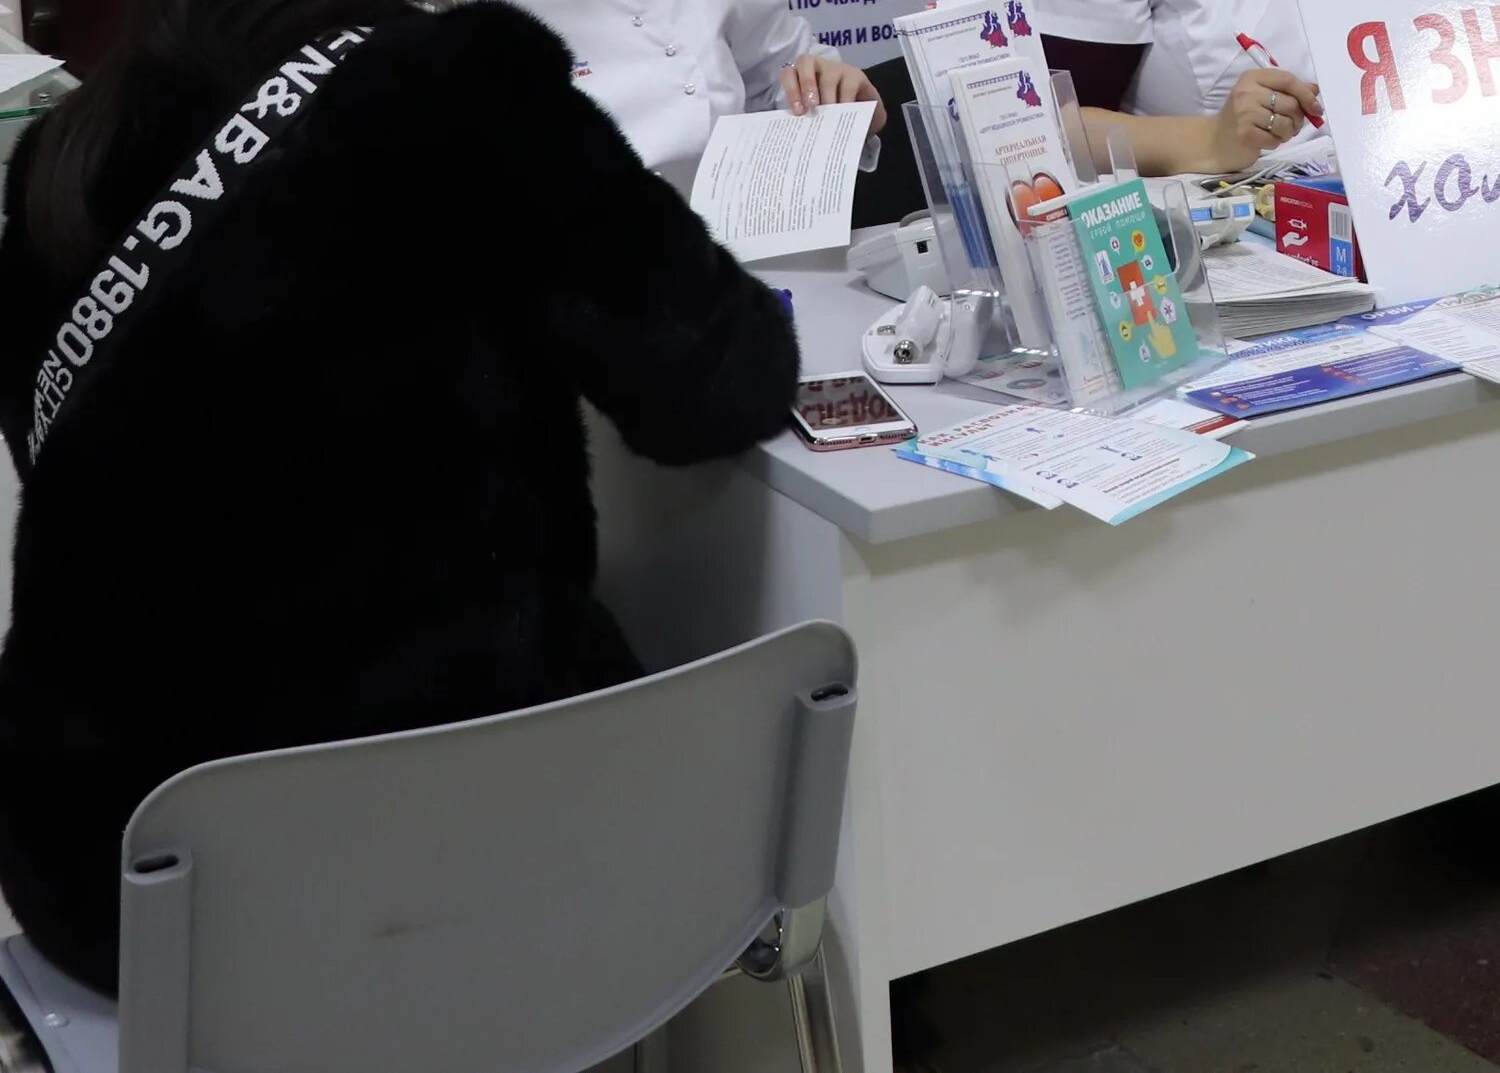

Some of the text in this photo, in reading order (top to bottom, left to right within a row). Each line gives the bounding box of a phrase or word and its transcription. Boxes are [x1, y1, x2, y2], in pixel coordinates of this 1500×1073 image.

[813, 27, 853, 47] НИЯ
[856, 25, 868, 43] И
[1345, 20, 1406, 116] Я
[1335, 245, 1347, 264] M
[1360, 304, 1412, 322] ОРВИ
